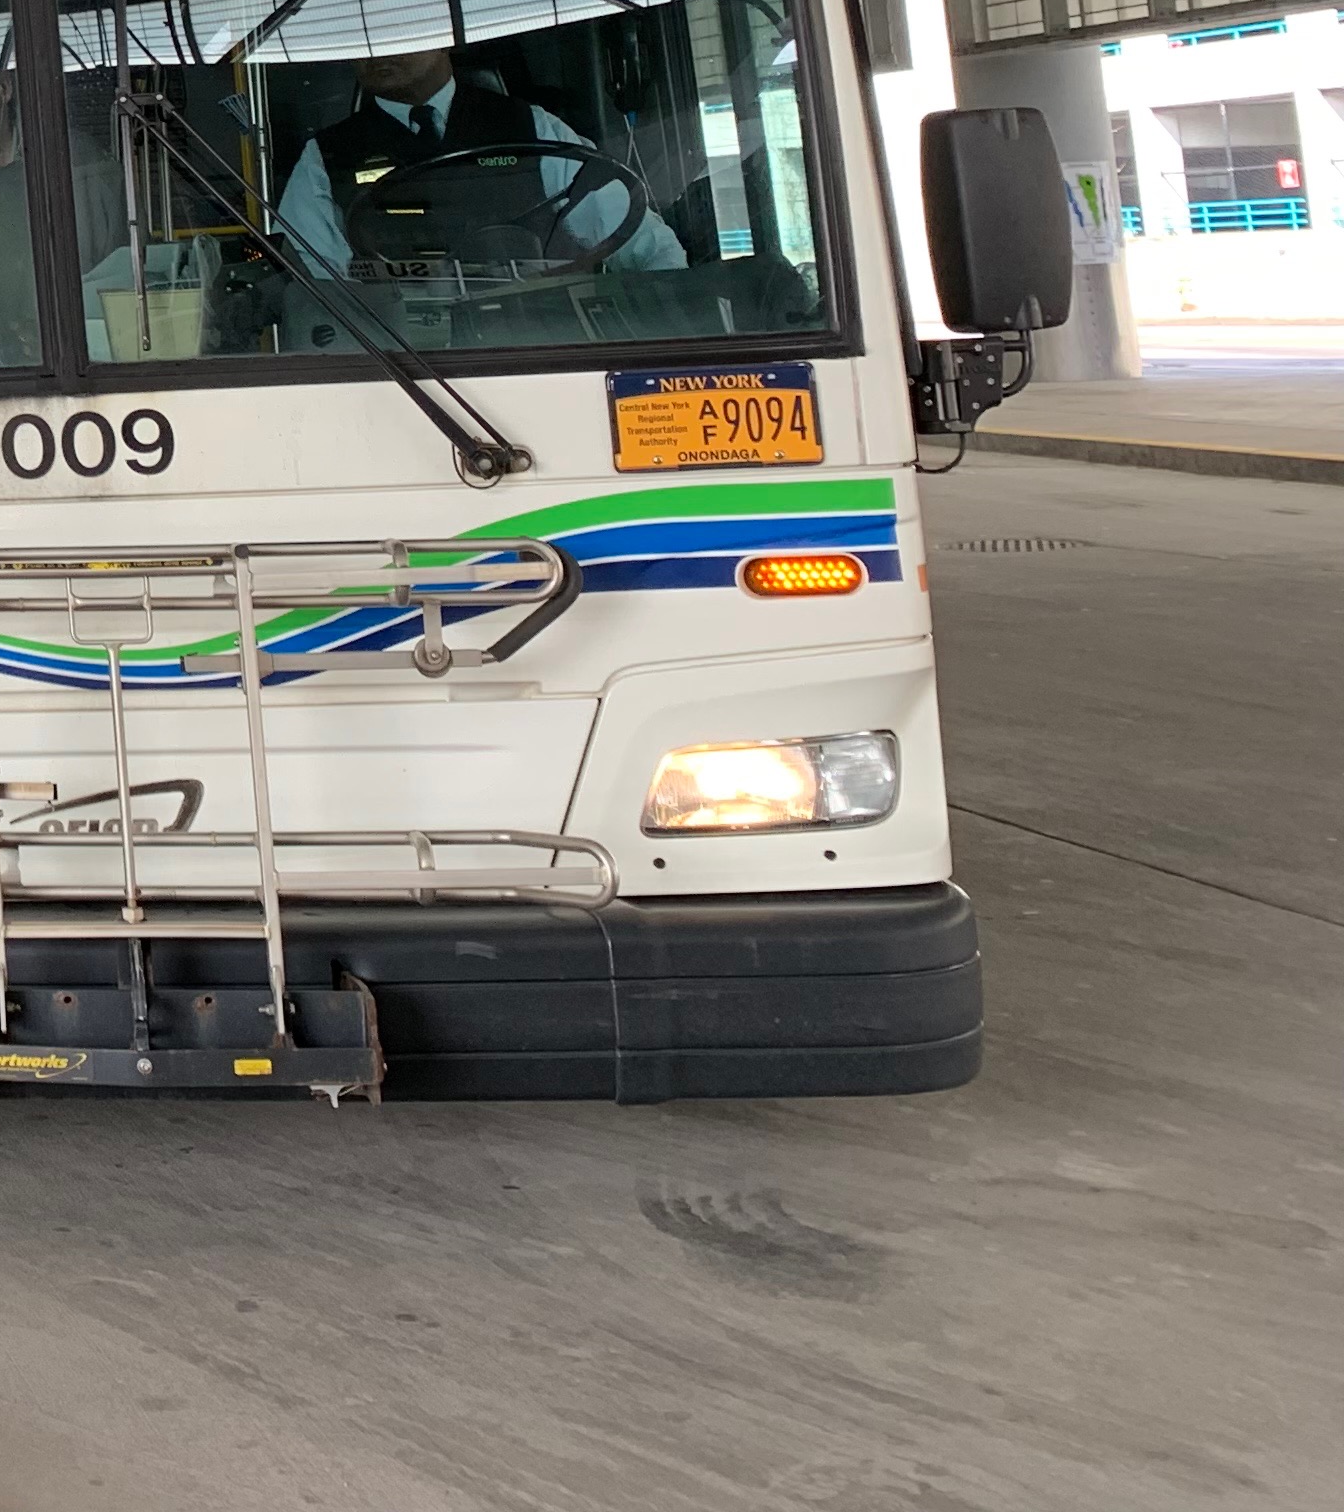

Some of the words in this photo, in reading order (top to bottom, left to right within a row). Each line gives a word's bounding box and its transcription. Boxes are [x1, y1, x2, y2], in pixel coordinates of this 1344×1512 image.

[658, 376, 708, 393] NEW
[711, 373, 766, 389] YORK
[618, 402, 650, 413] Central
[651, 402, 670, 411] New
[671, 401, 691, 410] York
[637, 413, 674, 424] Regional
[722, 395, 808, 444] 9094
[627, 425, 689, 436] Transportation
[639, 438, 678, 448] Authority
[677, 449, 761, 463] ONONDAGA
